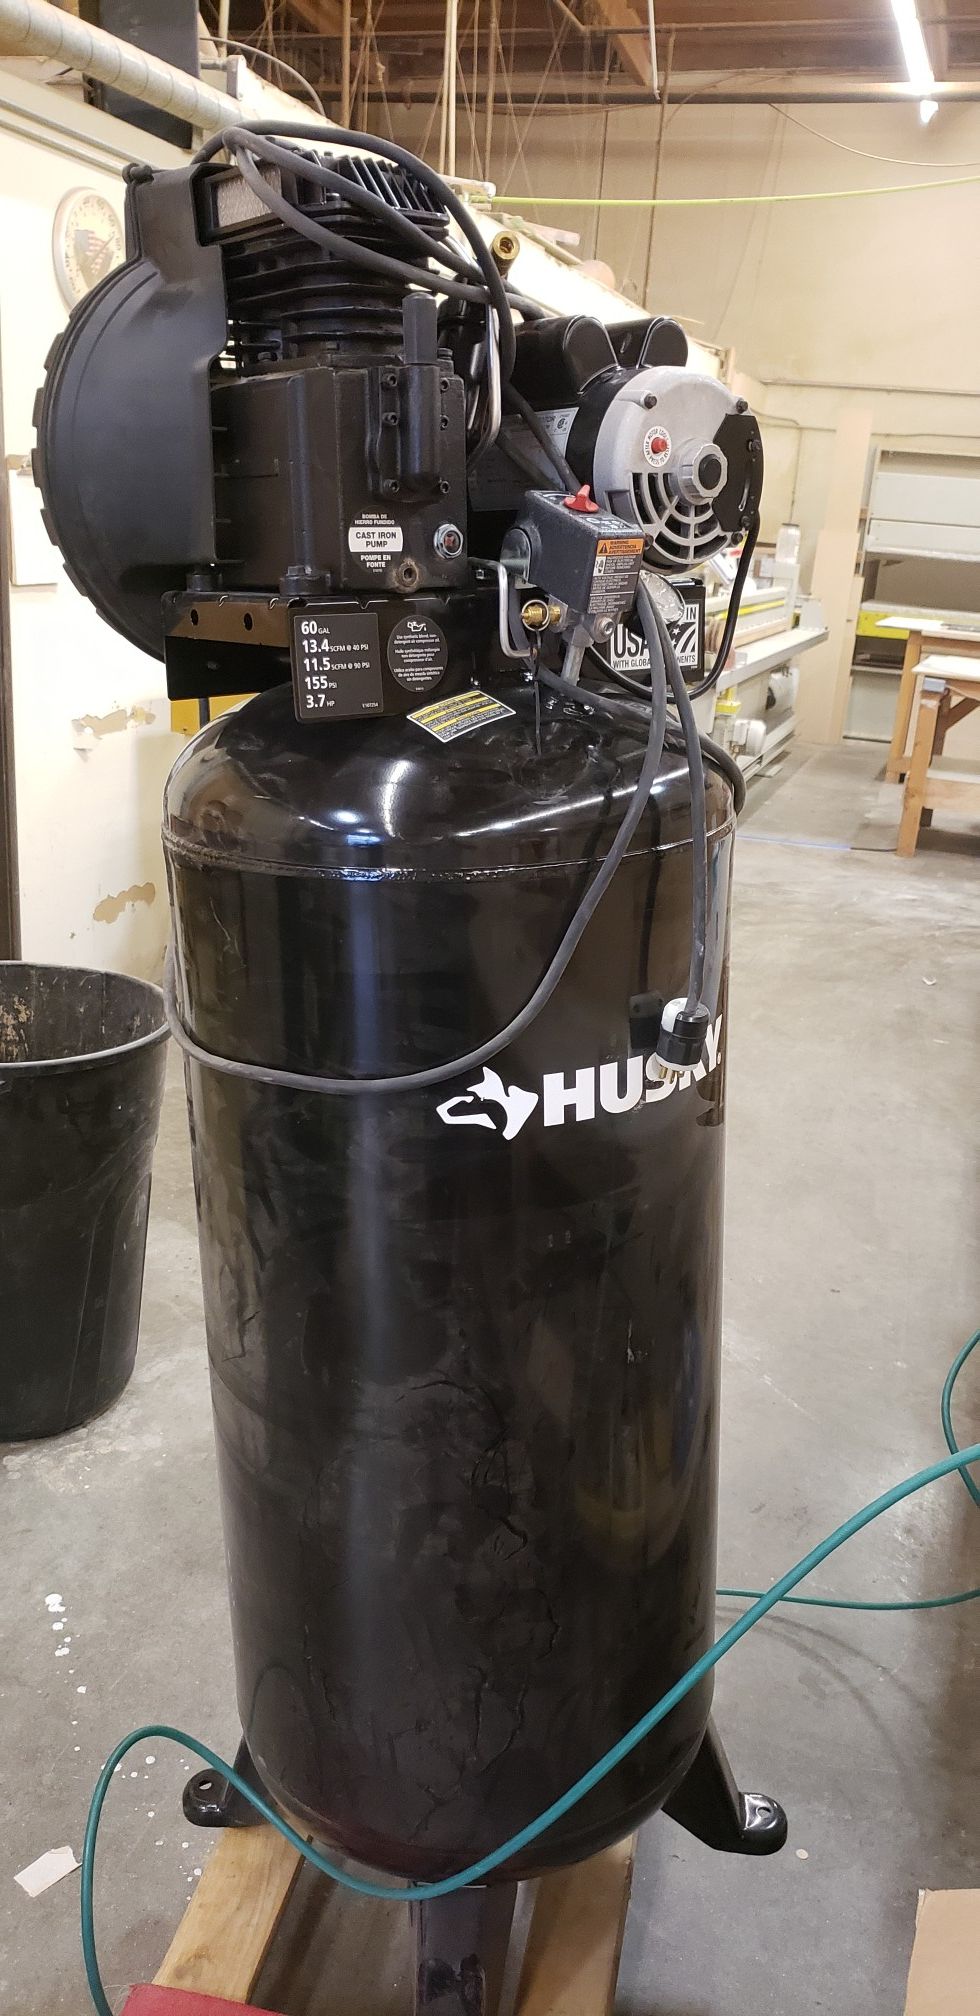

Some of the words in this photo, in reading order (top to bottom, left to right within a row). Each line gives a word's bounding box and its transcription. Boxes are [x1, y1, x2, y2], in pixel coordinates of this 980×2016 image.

[355, 531, 376, 539] CAST
[378, 531, 397, 539] IRON
[366, 540, 388, 548] PUMP
[686, 606, 697, 620] IN
[301, 620, 317, 635] 60
[318, 627, 330, 635] GAL
[302, 638, 330, 653] 13.4
[303, 657, 331, 671] 11.5
[613, 659, 630, 668] WITH
[631, 658, 650, 667] GLOBA
[304, 675, 328, 690] 155
[306, 694, 326, 708] 3.7
